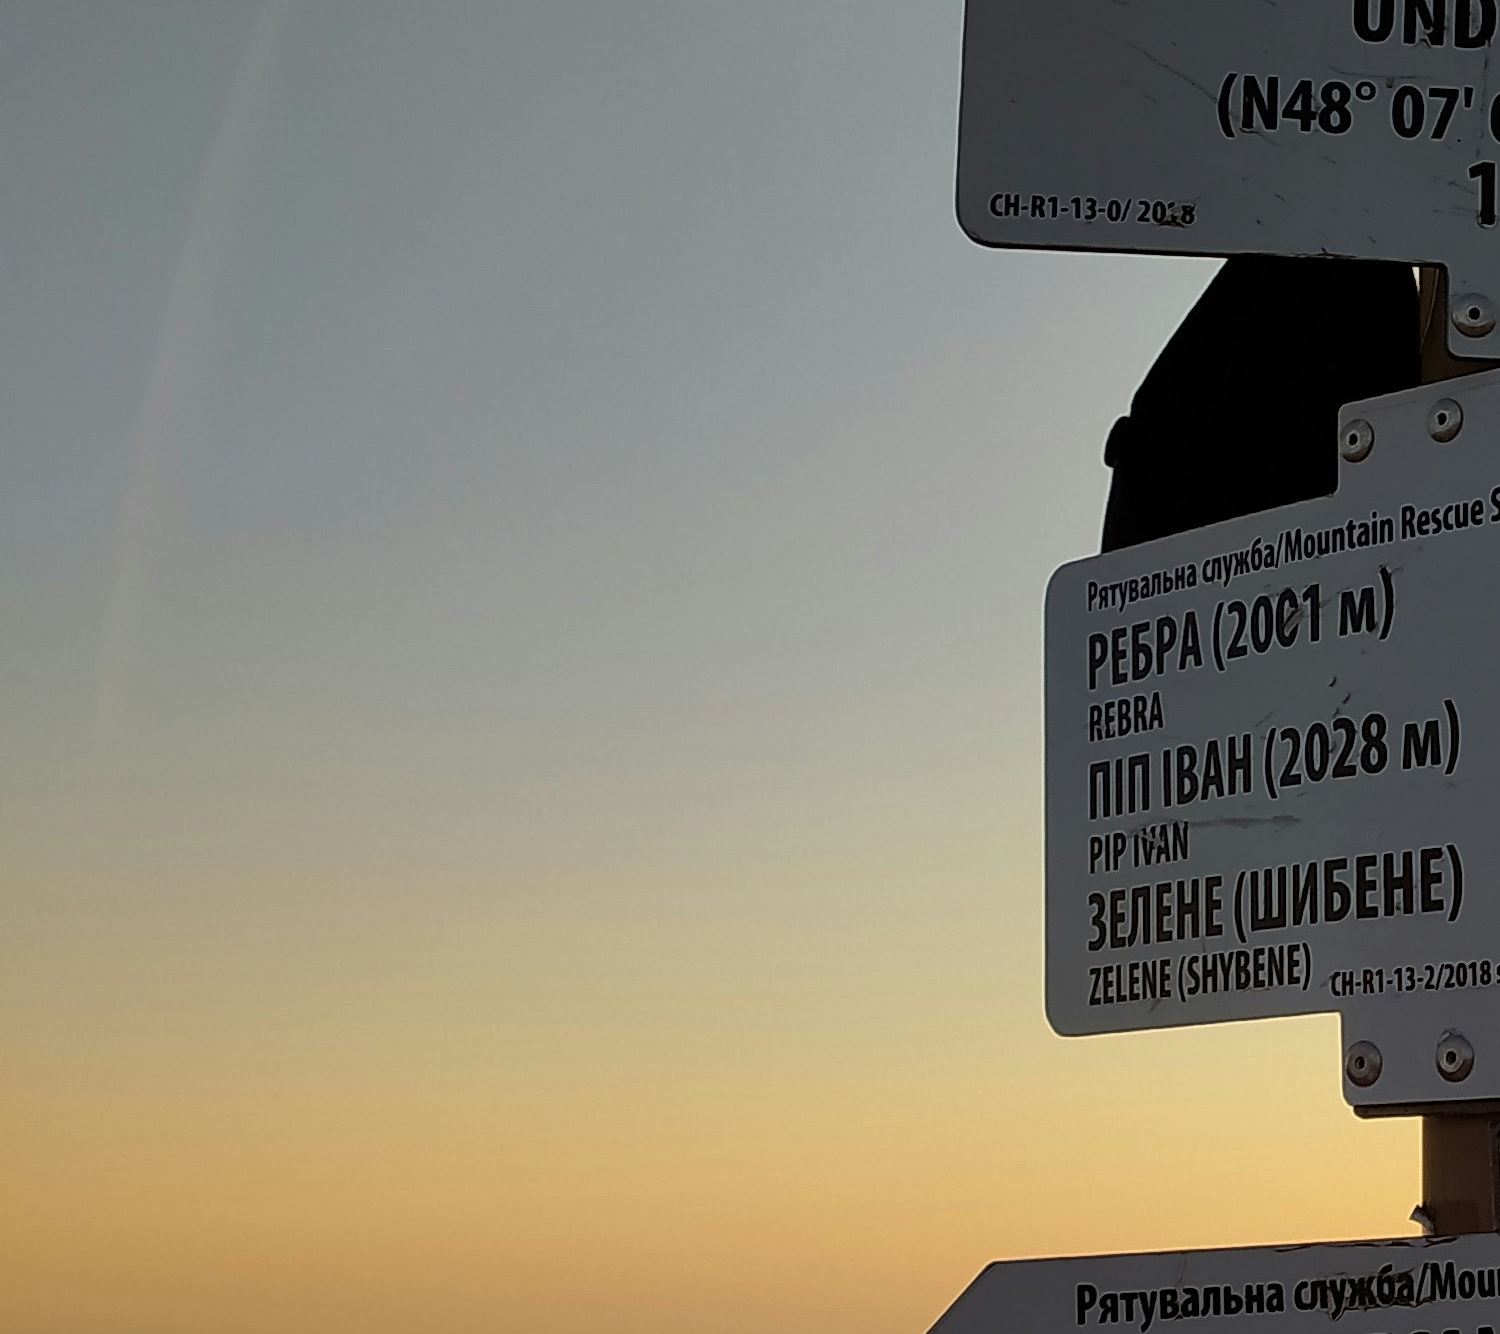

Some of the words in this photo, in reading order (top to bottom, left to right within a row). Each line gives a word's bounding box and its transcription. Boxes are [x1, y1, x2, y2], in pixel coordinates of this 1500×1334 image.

[1217, 73, 1377, 139] (N48°
[989, 193, 1132, 222] CH-R1-13-0/
[1088, 564, 1197, 613] Рятувальна
[1202, 511, 1394, 588] служба/Mountain
[1401, 499, 1484, 540] Rescue
[1088, 611, 1203, 690] РЕБРА
[1213, 583, 1321, 672] (2001
[1339, 564, 1395, 640] м)
[1089, 691, 1164, 742] REBRA
[1089, 761, 1150, 820] ПІП
[1162, 733, 1252, 808] ІВАН
[1264, 708, 1388, 799] (2028
[1402, 699, 1460, 775] м)
[1089, 832, 1127, 875] PIP
[1133, 820, 1189, 868] IVAN
[1088, 875, 1223, 952] ЗЕЛЕНЕ
[1234, 844, 1463, 944] (ШИБЕНЕ)
[1089, 958, 1172, 1007] ZELENE
[1178, 942, 1311, 1003] (SHYBENE)
[1329, 960, 1492, 997] CH-R1-13-2/2018
[1076, 1283, 1285, 1333] Рятувальна
